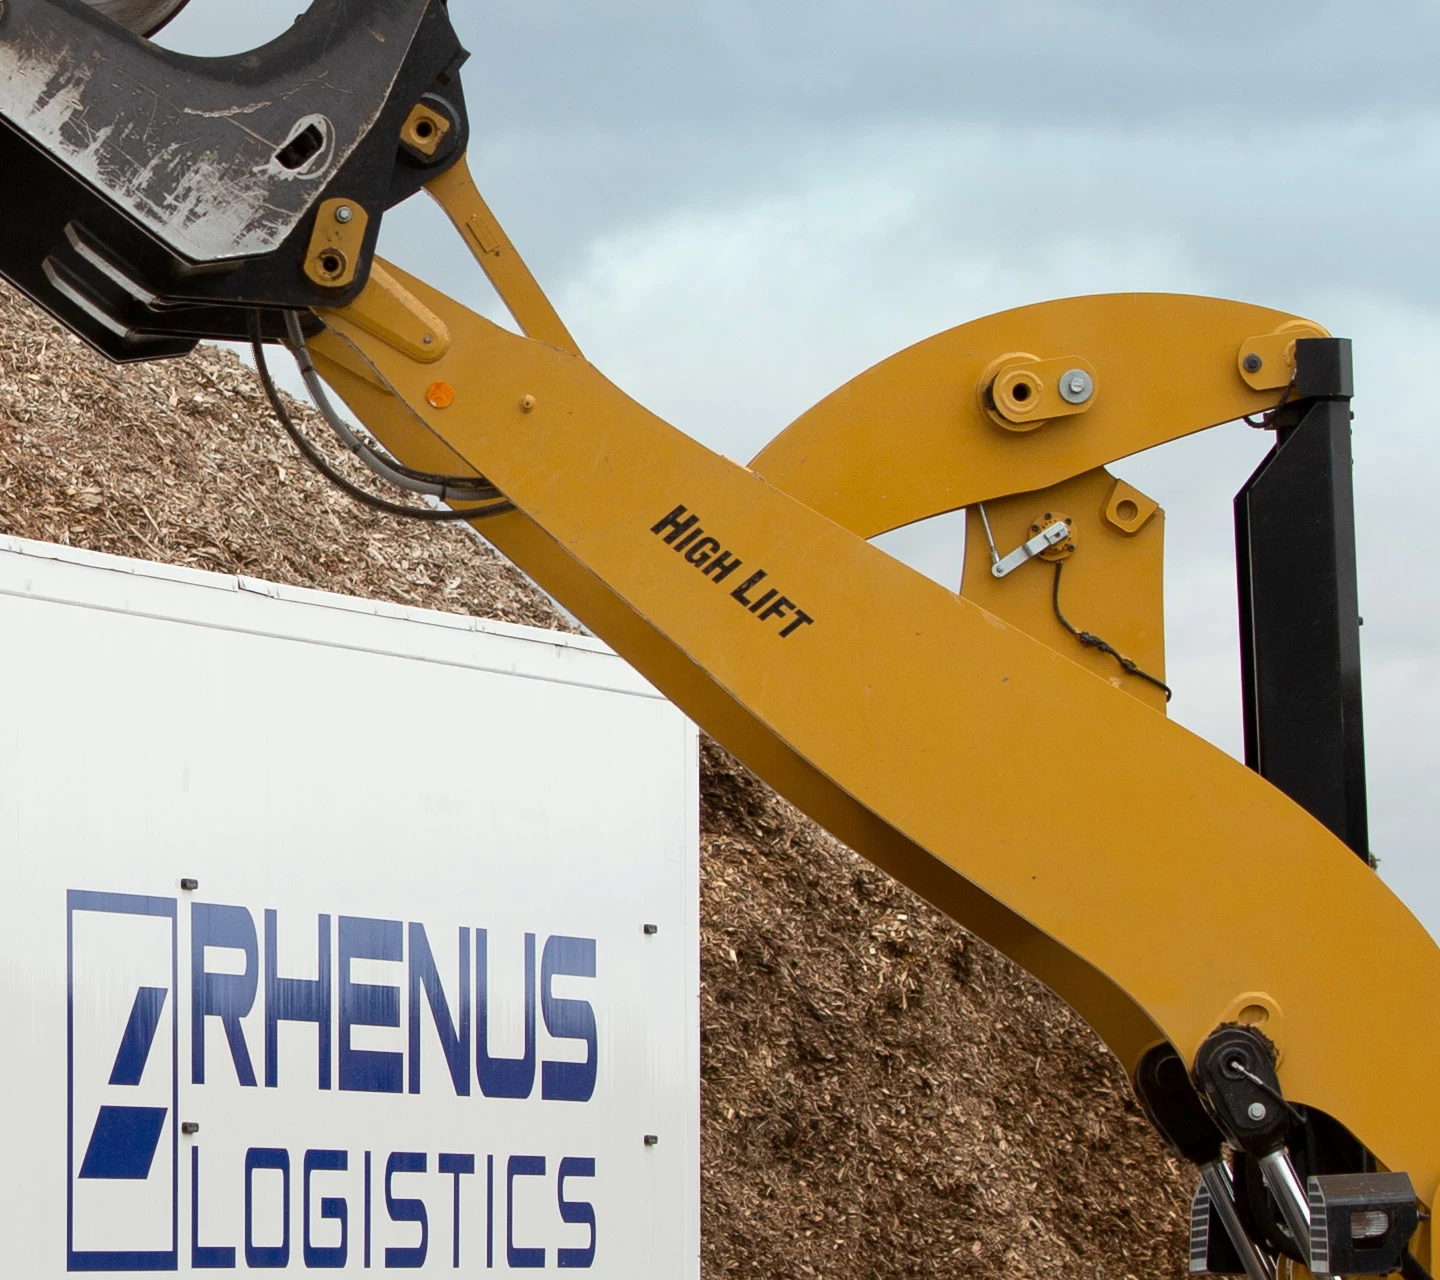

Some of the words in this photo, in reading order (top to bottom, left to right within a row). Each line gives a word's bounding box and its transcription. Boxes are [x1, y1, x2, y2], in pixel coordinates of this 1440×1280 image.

[649, 504, 743, 584] HIGH
[729, 568, 815, 639] LIFT
[190, 901, 597, 1102] RHENUS
[190, 1145, 597, 1269] LOGISTICS
